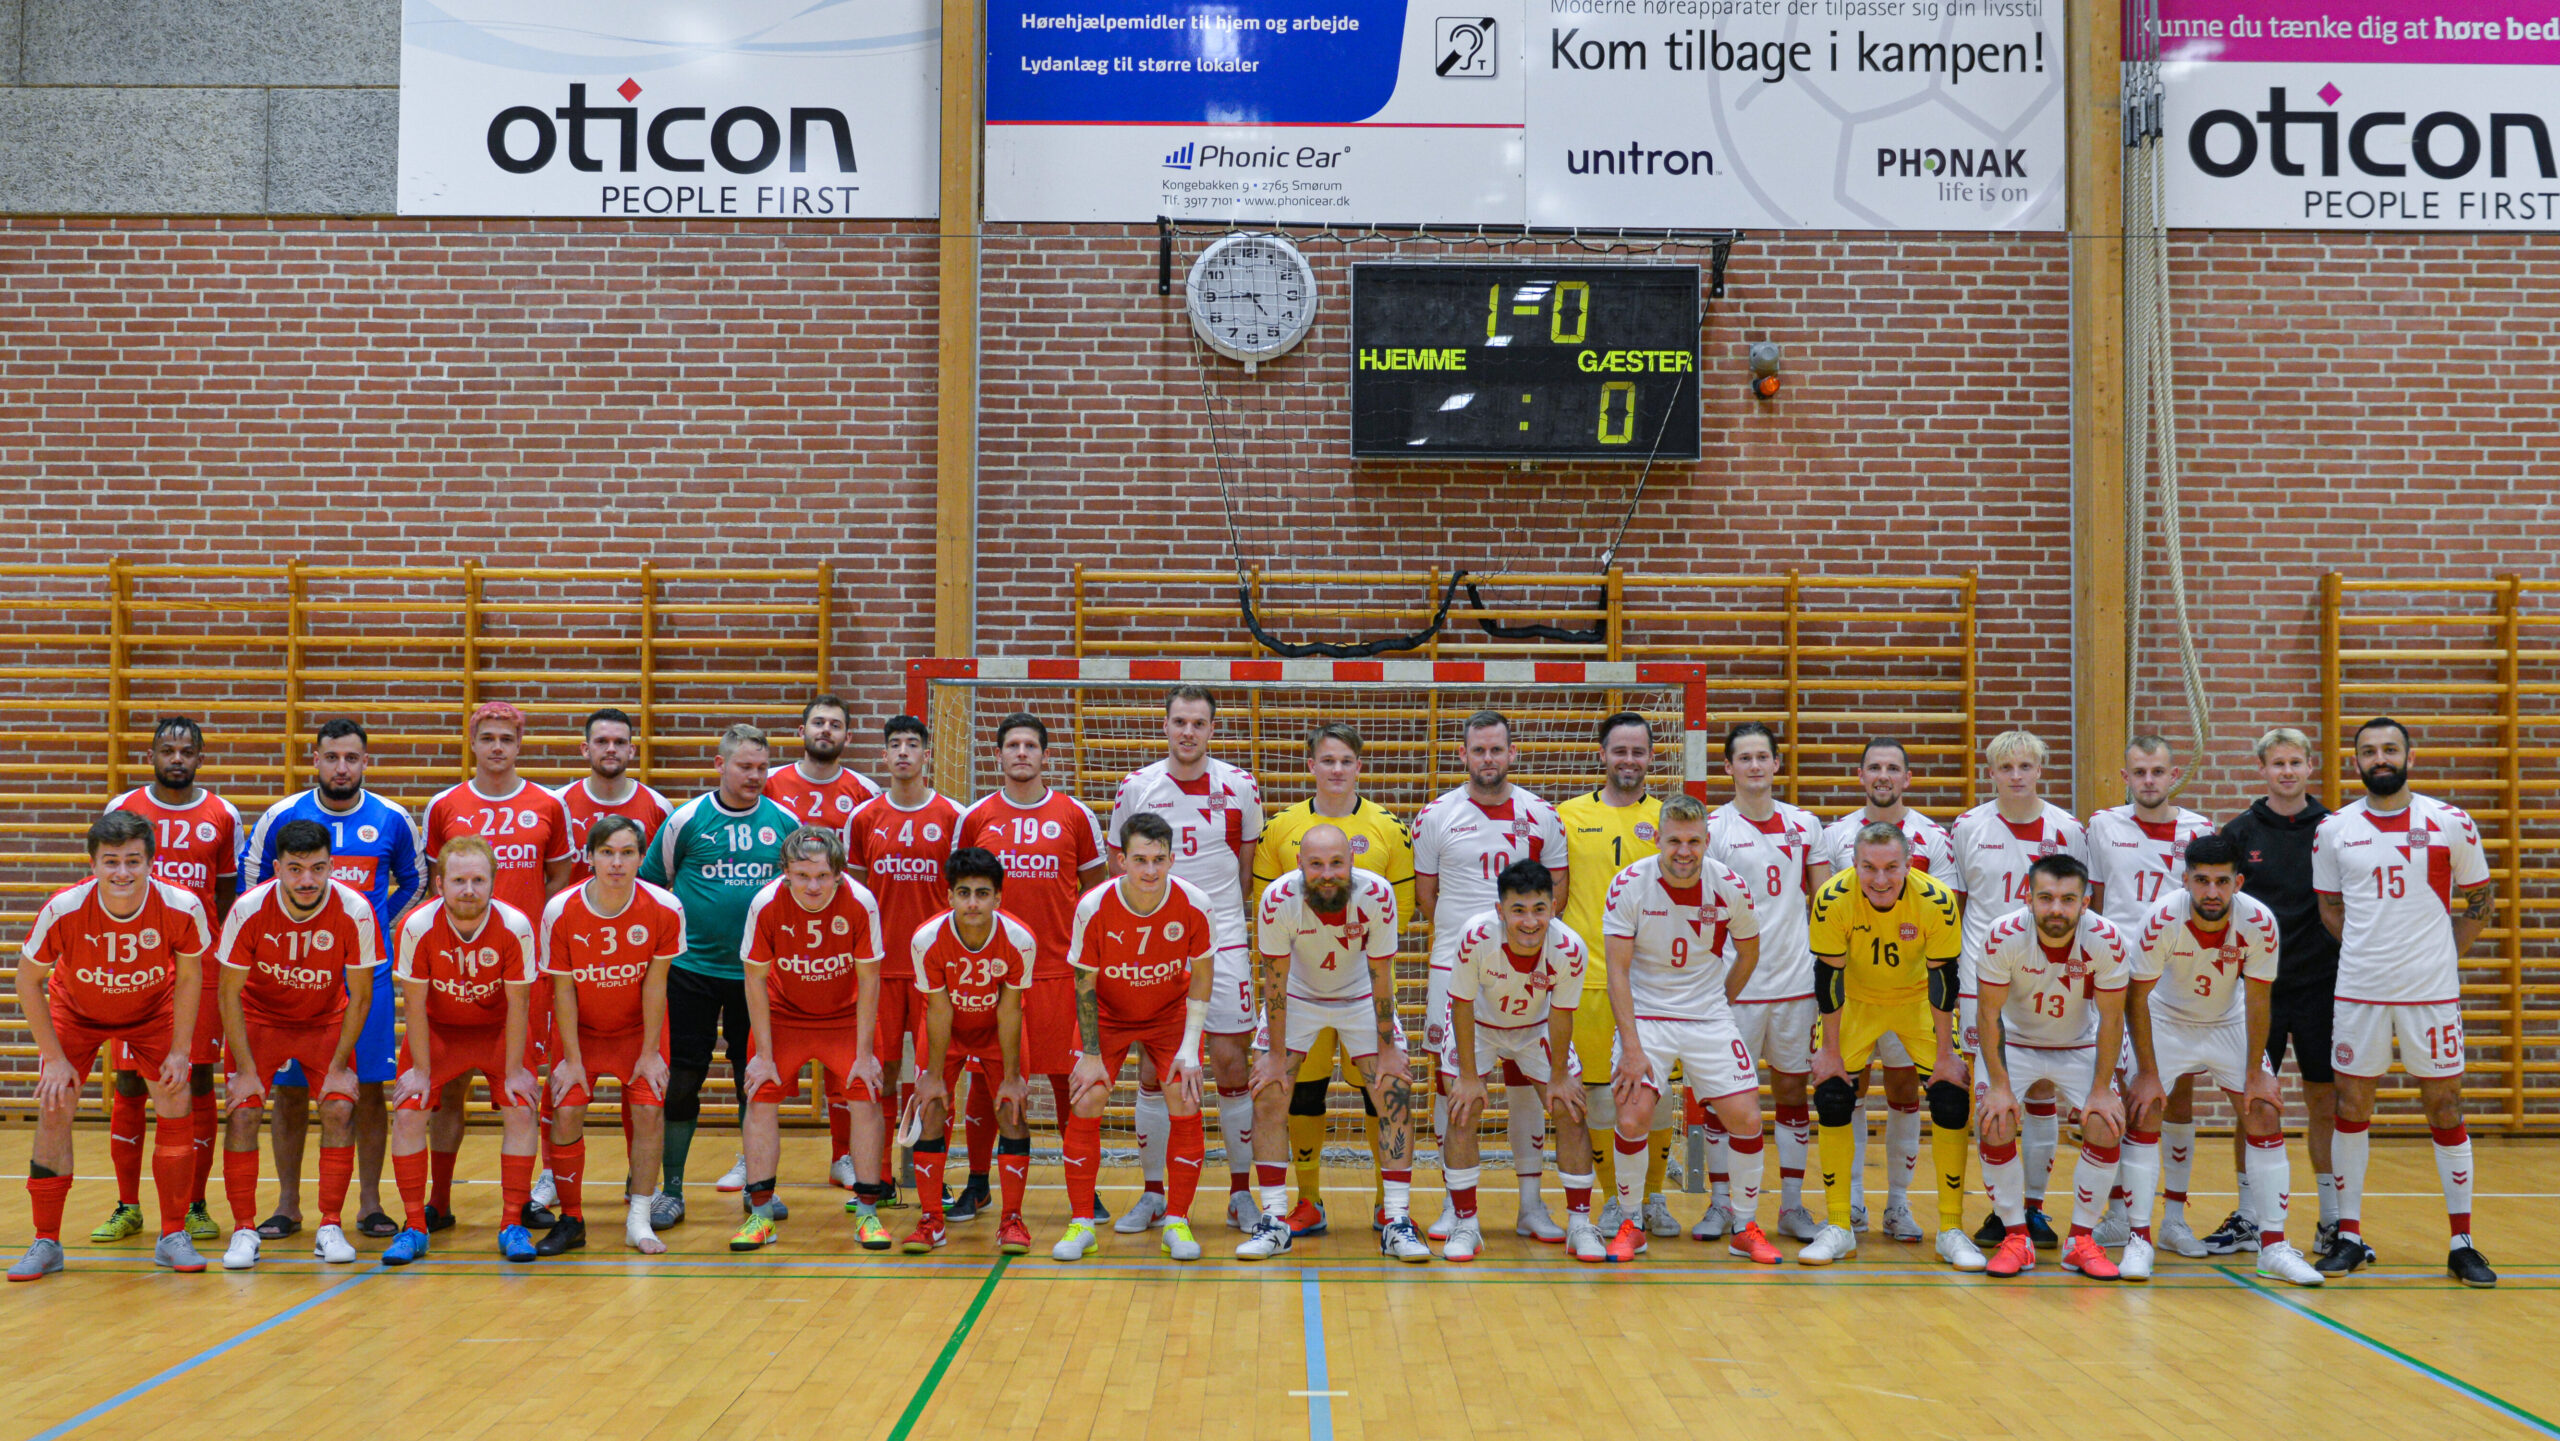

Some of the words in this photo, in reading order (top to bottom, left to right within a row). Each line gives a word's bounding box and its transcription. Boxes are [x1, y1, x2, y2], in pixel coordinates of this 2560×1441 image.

[1550, 0, 1636, 15] Moderne
[1644, 0, 1781, 20] høreapparater
[1787, 0, 1816, 16] der
[1826, 0, 1906, 21] tilpasser
[1912, 0, 1939, 21] sig
[1946, 0, 1976, 17] din
[1984, 0, 2043, 17] livsstil
[1021, 13, 1186, 33] Hørehjælpemidler
[1191, 15, 1211, 30] til
[1215, 15, 1260, 34] hjem
[1265, 18, 1288, 34] og
[1292, 15, 1360, 34] arbejde
[2230, 14, 2263, 38] du
[2268, 15, 2353, 39] tænke
[2358, 15, 2398, 45] dig
[2403, 18, 2430, 40] at
[2434, 16, 2501, 41] høre
[2506, 16, 2560, 41] bed
[1021, 56, 1109, 76] Lydanlæg
[1114, 57, 1133, 72] til
[1138, 57, 1192, 72] større
[1197, 57, 1260, 72] lokaler
[1551, 27, 1647, 70] Kom
[1664, 29, 1811, 84] tilbage
[1829, 30, 1838, 72] i
[1858, 30, 2044, 85] kampen!
[486, 77, 858, 175] oticon
[2188, 81, 2559, 180] oticon
[1199, 145, 1290, 168] Phonic
[1567, 140, 1714, 176] unitron
[1877, 147, 2028, 178] PHONAK
[1162, 179, 1239, 193] Kongebakken
[1242, 182, 1250, 193] 9
[1261, 180, 1289, 193] 2765
[1292, 179, 1342, 191] Smørum
[1938, 181, 1974, 202] life
[1979, 182, 1996, 202] is
[2001, 187, 2029, 202] on
[602, 186, 738, 214] PEOPLE
[758, 186, 860, 215] FIRST
[1162, 194, 1180, 206] Tlf.
[1184, 196, 1208, 208] 3917
[1211, 196, 1233, 208] 7101
[1245, 195, 1350, 208] www.phonicear.dk
[2305, 191, 2440, 219] PEOPLE
[2460, 191, 2560, 220] FIRST
[1359, 348, 1467, 371] HJEMME
[1577, 350, 1694, 373] GÆSTER
[1598, 381, 1637, 444] 0
[807, 791, 824, 817] 2
[479, 806, 515, 836] 22
[898, 820, 914, 847] 4
[1011, 818, 1039, 845] 19
[1450, 824, 1478, 834] hummel
[157, 819, 191, 849] 12
[331, 822, 344, 848] 1
[724, 823, 753, 852] 18
[1181, 826, 1198, 857] 5
[1729, 840, 1755, 850] hummel
[1977, 842, 2005, 851] hummel
[2111, 839, 2139, 849] hummel
[2343, 838, 2373, 848] hummel
[494, 844, 537, 861] con
[996, 849, 1059, 870] ticon
[1611, 836, 1622, 866] 1
[154, 855, 207, 880] icon
[701, 858, 773, 879] oticon
[873, 853, 938, 875] oticon
[1007, 870, 1036, 878] PEOPLE
[1038, 871, 1058, 879] FIRST
[1479, 851, 1509, 880] 10
[724, 879, 754, 887] PEOPLE
[1766, 865, 1782, 897] 8
[2002, 871, 2031, 904] 14
[2134, 869, 2164, 902] 17
[2372, 864, 2405, 899] 15
[1642, 908, 1668, 917] hummel
[286, 930, 313, 961] 11
[600, 926, 617, 956] 3
[806, 919, 823, 949] 5
[1136, 926, 1152, 956] 7
[103, 931, 138, 963] 13
[1671, 937, 1688, 968] 9
[1871, 937, 1900, 968] 16
[2172, 949, 2195, 957] ummel
[257, 960, 332, 982] oticon
[454, 946, 479, 978] 14
[573, 961, 648, 982] oticon
[778, 952, 853, 975] oticon
[959, 956, 992, 987] 23
[1104, 958, 1182, 980] oticon
[1319, 951, 1337, 971] 4
[76, 965, 165, 988] oticon
[597, 978, 628, 989] PEOPLE
[801, 972, 832, 982] PEOPLE
[1130, 977, 1161, 987] PEOPLE
[2194, 974, 2212, 997] 3
[102, 985, 138, 995] PEOPLE
[949, 989, 999, 1008] tico
[1239, 980, 1251, 1013] 5
[1499, 996, 1528, 1016] 12
[2033, 991, 2065, 1018] 13
[2426, 1024, 2458, 1060] 15
[1731, 1039, 1750, 1071] 9
[2435, 1060, 2461, 1070] hummel
